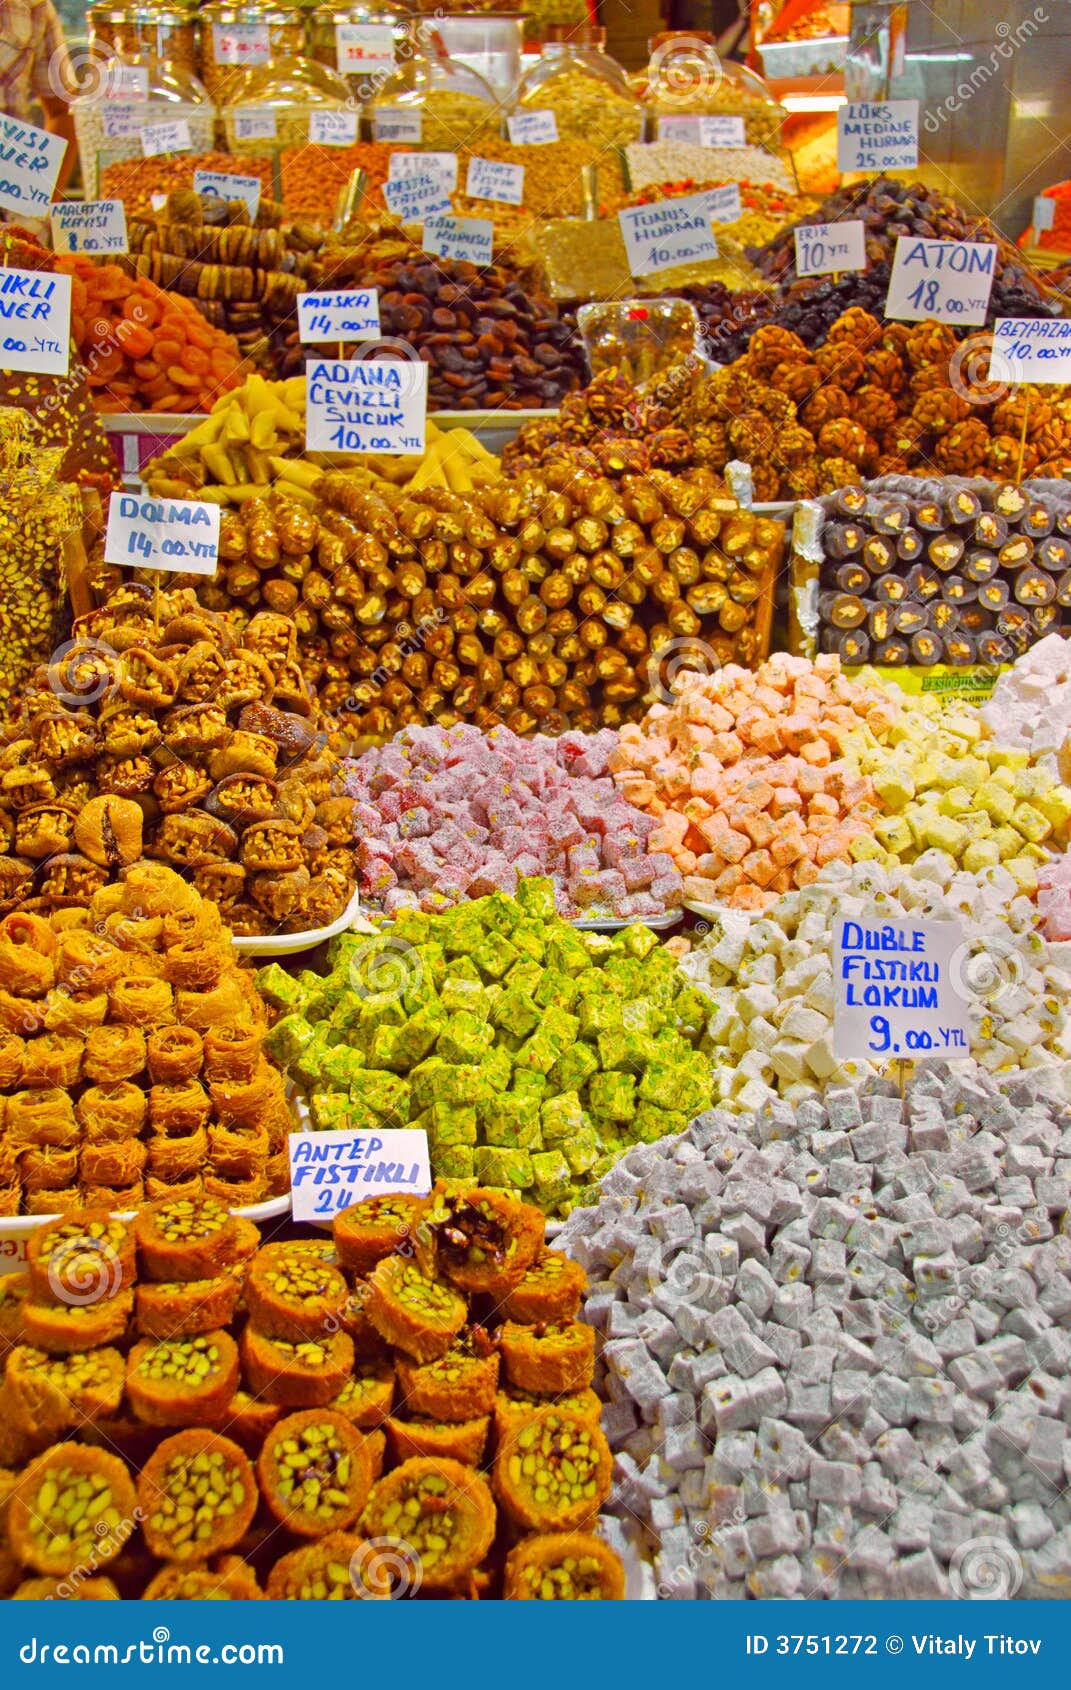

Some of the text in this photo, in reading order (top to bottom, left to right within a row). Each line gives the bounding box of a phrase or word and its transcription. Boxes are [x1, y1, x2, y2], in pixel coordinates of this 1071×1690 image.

[848, 103, 893, 119] LÜKS
[0, 120, 50, 151] YISI
[53, 202, 115, 217] MALATYA
[634, 216, 706, 242] HURMA
[903, 242, 994, 275] ATOM
[0, 273, 56, 300] IKLI
[303, 294, 370, 308] MUSKA
[311, 363, 401, 387] ADANA
[325, 407, 405, 428] SUCUK
[120, 497, 211, 526] DOLMA
[842, 921, 926, 953] DUBLE
[846, 983, 939, 1009] LOKUM
[292, 1137, 383, 1163] ANTEP
[292, 1160, 420, 1187] FISTIKLI
